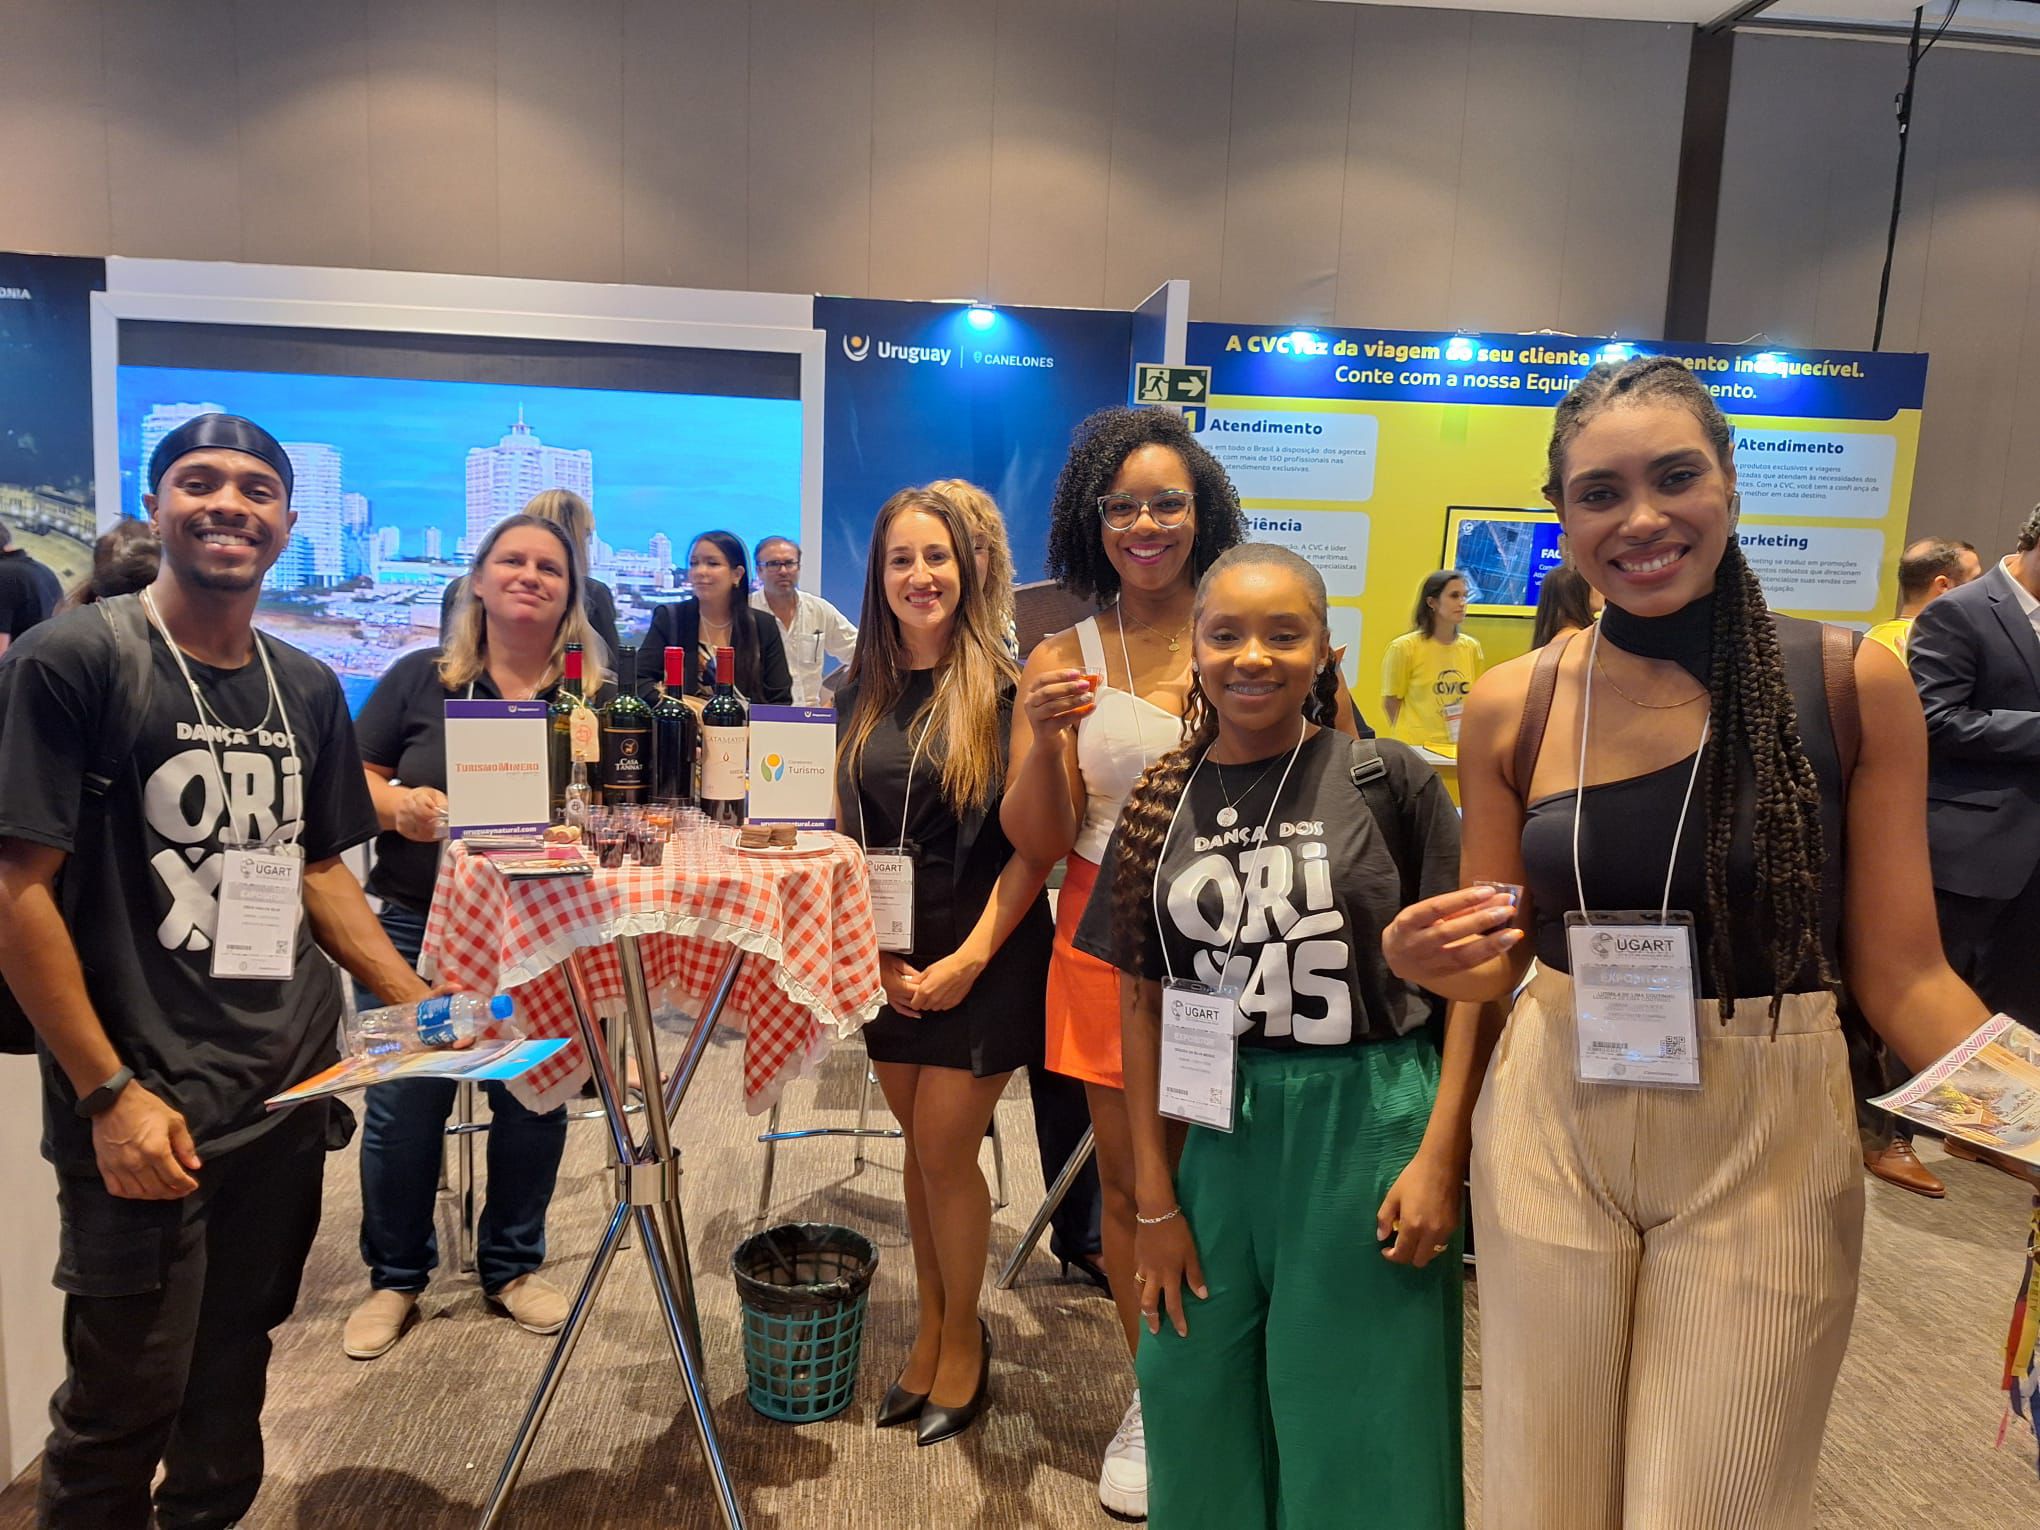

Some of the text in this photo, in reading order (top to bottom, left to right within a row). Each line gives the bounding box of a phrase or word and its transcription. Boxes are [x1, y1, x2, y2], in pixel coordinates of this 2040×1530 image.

[0, 287, 32, 300] ONIA
[877, 341, 951, 366] Uruguay
[1225, 335, 1242, 352] A
[1247, 336, 1291, 354] CVC
[1333, 340, 1358, 356] da
[1363, 340, 1440, 362] viagem
[1477, 348, 1514, 362] seu
[1519, 347, 1590, 366] cliente
[984, 354, 1054, 368] CANELONES
[1335, 365, 1394, 384] Conte
[1400, 371, 1440, 386] com
[1447, 374, 1458, 387] a
[1463, 374, 1520, 389] nossa
[1184, 410, 1197, 433] 1
[1209, 419, 1323, 435] Atendimento
[1253, 444, 1274, 452] Brasil
[1281, 445, 1320, 456] disposição
[1322, 447, 1337, 455] dos
[1338, 449, 1367, 458] agentes
[1737, 438, 1844, 454] Atendimento
[1239, 454, 1257, 462] mais
[1258, 454, 1267, 462] de
[1283, 455, 1330, 465] profissionais
[1739, 463, 1771, 471] produtos
[1772, 464, 1808, 472] exclusivos
[1815, 465, 1841, 473] viagens
[1777, 472, 1807, 481] atendam
[1817, 474, 1863, 483] necessidades
[1797, 482, 1812, 490] você
[1245, 517, 1302, 532] riência
[1737, 534, 1808, 550] arketing
[1778, 567, 1808, 575] robustos
[176, 722, 296, 748] DANÇA DOS
[788, 766, 825, 775] Turismo
[1194, 821, 1325, 852] DANÇA DOS
[256, 863, 293, 877] UGART
[873, 863, 903, 872] UGART
[1616, 939, 1674, 952] UGART
[1184, 1006, 1220, 1021] UGART
